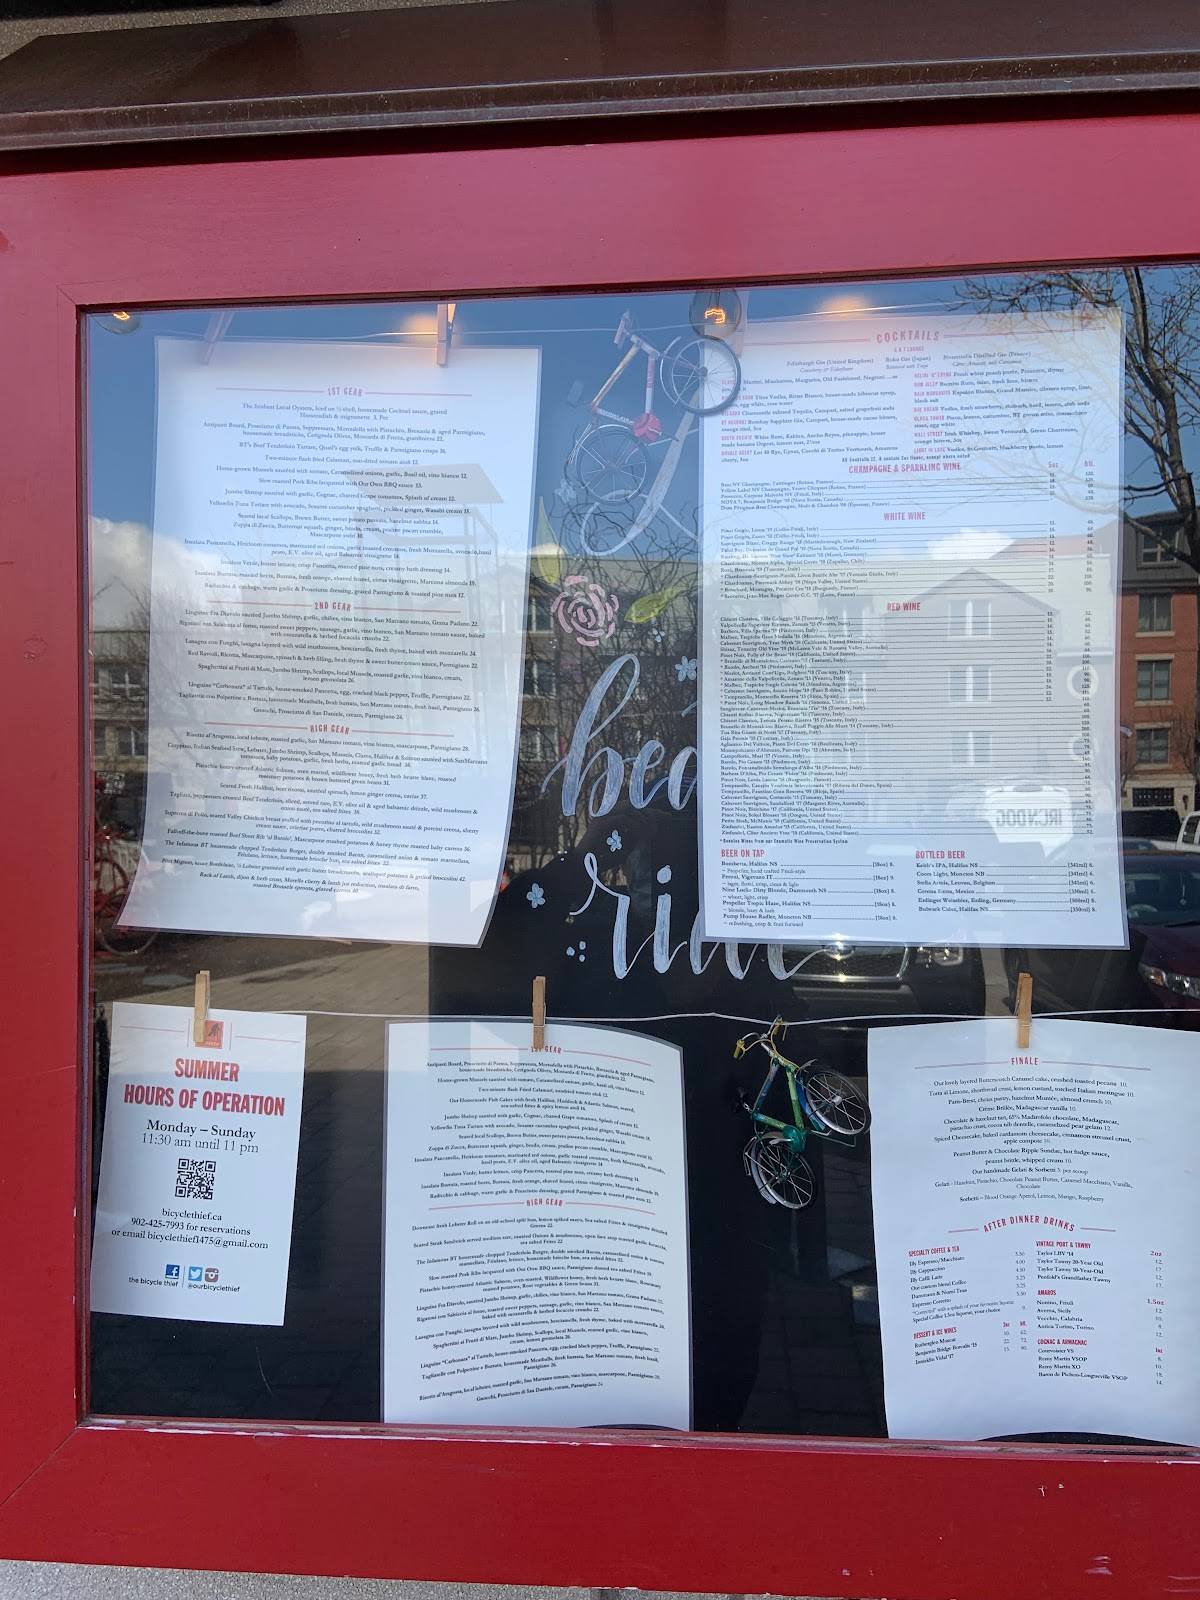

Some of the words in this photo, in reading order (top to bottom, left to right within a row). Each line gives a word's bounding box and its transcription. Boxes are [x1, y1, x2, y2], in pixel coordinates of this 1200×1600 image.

[876, 330, 940, 344] COCKTAILS
[327, 387, 340, 396] 1ST
[343, 387, 363, 397] GEAR
[848, 464, 893, 474] CHAMPAGNE
[901, 463, 941, 473] SPARKLING
[942, 462, 961, 471] WINE
[883, 512, 906, 521] WHITE
[907, 511, 926, 520] WINE
[314, 601, 329, 610] 2ND
[332, 602, 352, 612] GEAR
[887, 602, 901, 612] RED
[902, 602, 921, 611] WINE
[310, 724, 328, 733] HIGH
[331, 725, 350, 735] GEAR
[721, 849, 738, 858] BEER
[740, 849, 750, 858] ON
[752, 849, 765, 858] TAP
[915, 850, 945, 859] BOTTLED
[947, 850, 965, 860] BEER
[544, 1045, 562, 1054] GEAR
[1010, 1056, 1039, 1066] FINALE
[174, 1057, 240, 1082] SUMMER
[123, 1083, 174, 1108] HOURS
[178, 1088, 199, 1109] OF
[202, 1090, 286, 1117] OPERATION
[146, 1119, 198, 1136] Monday
[211, 1124, 257, 1142] Sunday
[142, 1132, 172, 1146] 11:30
[174, 1137, 191, 1147] am
[194, 1138, 220, 1150] until
[224, 1139, 235, 1151] 11
[239, 1143, 259, 1156] pm
[526, 1198, 543, 1207] HIGH
[545, 1198, 563, 1207] GEAR
[161, 1207, 223, 1222] bicyclethief.ca
[131, 1217, 185, 1230] 902-425-7993
[186, 1222, 198, 1232] for
[199, 1225, 251, 1236] reservations
[983, 1218, 1007, 1233] AFTER
[1009, 1214, 1040, 1225] DINNER
[1043, 1216, 1076, 1232] DRINKS
[122, 1228, 146, 1239] email
[147, 1231, 269, 1249] bicyclethief1475@gmail.com
[1036, 1240, 1055, 1248] VINTAGE
[908, 1248, 930, 1258] SPECIALTY
[930, 1246, 946, 1255] COFFEE
[128, 1276, 140, 1284] the
[140, 1277, 163, 1286] bicycle
